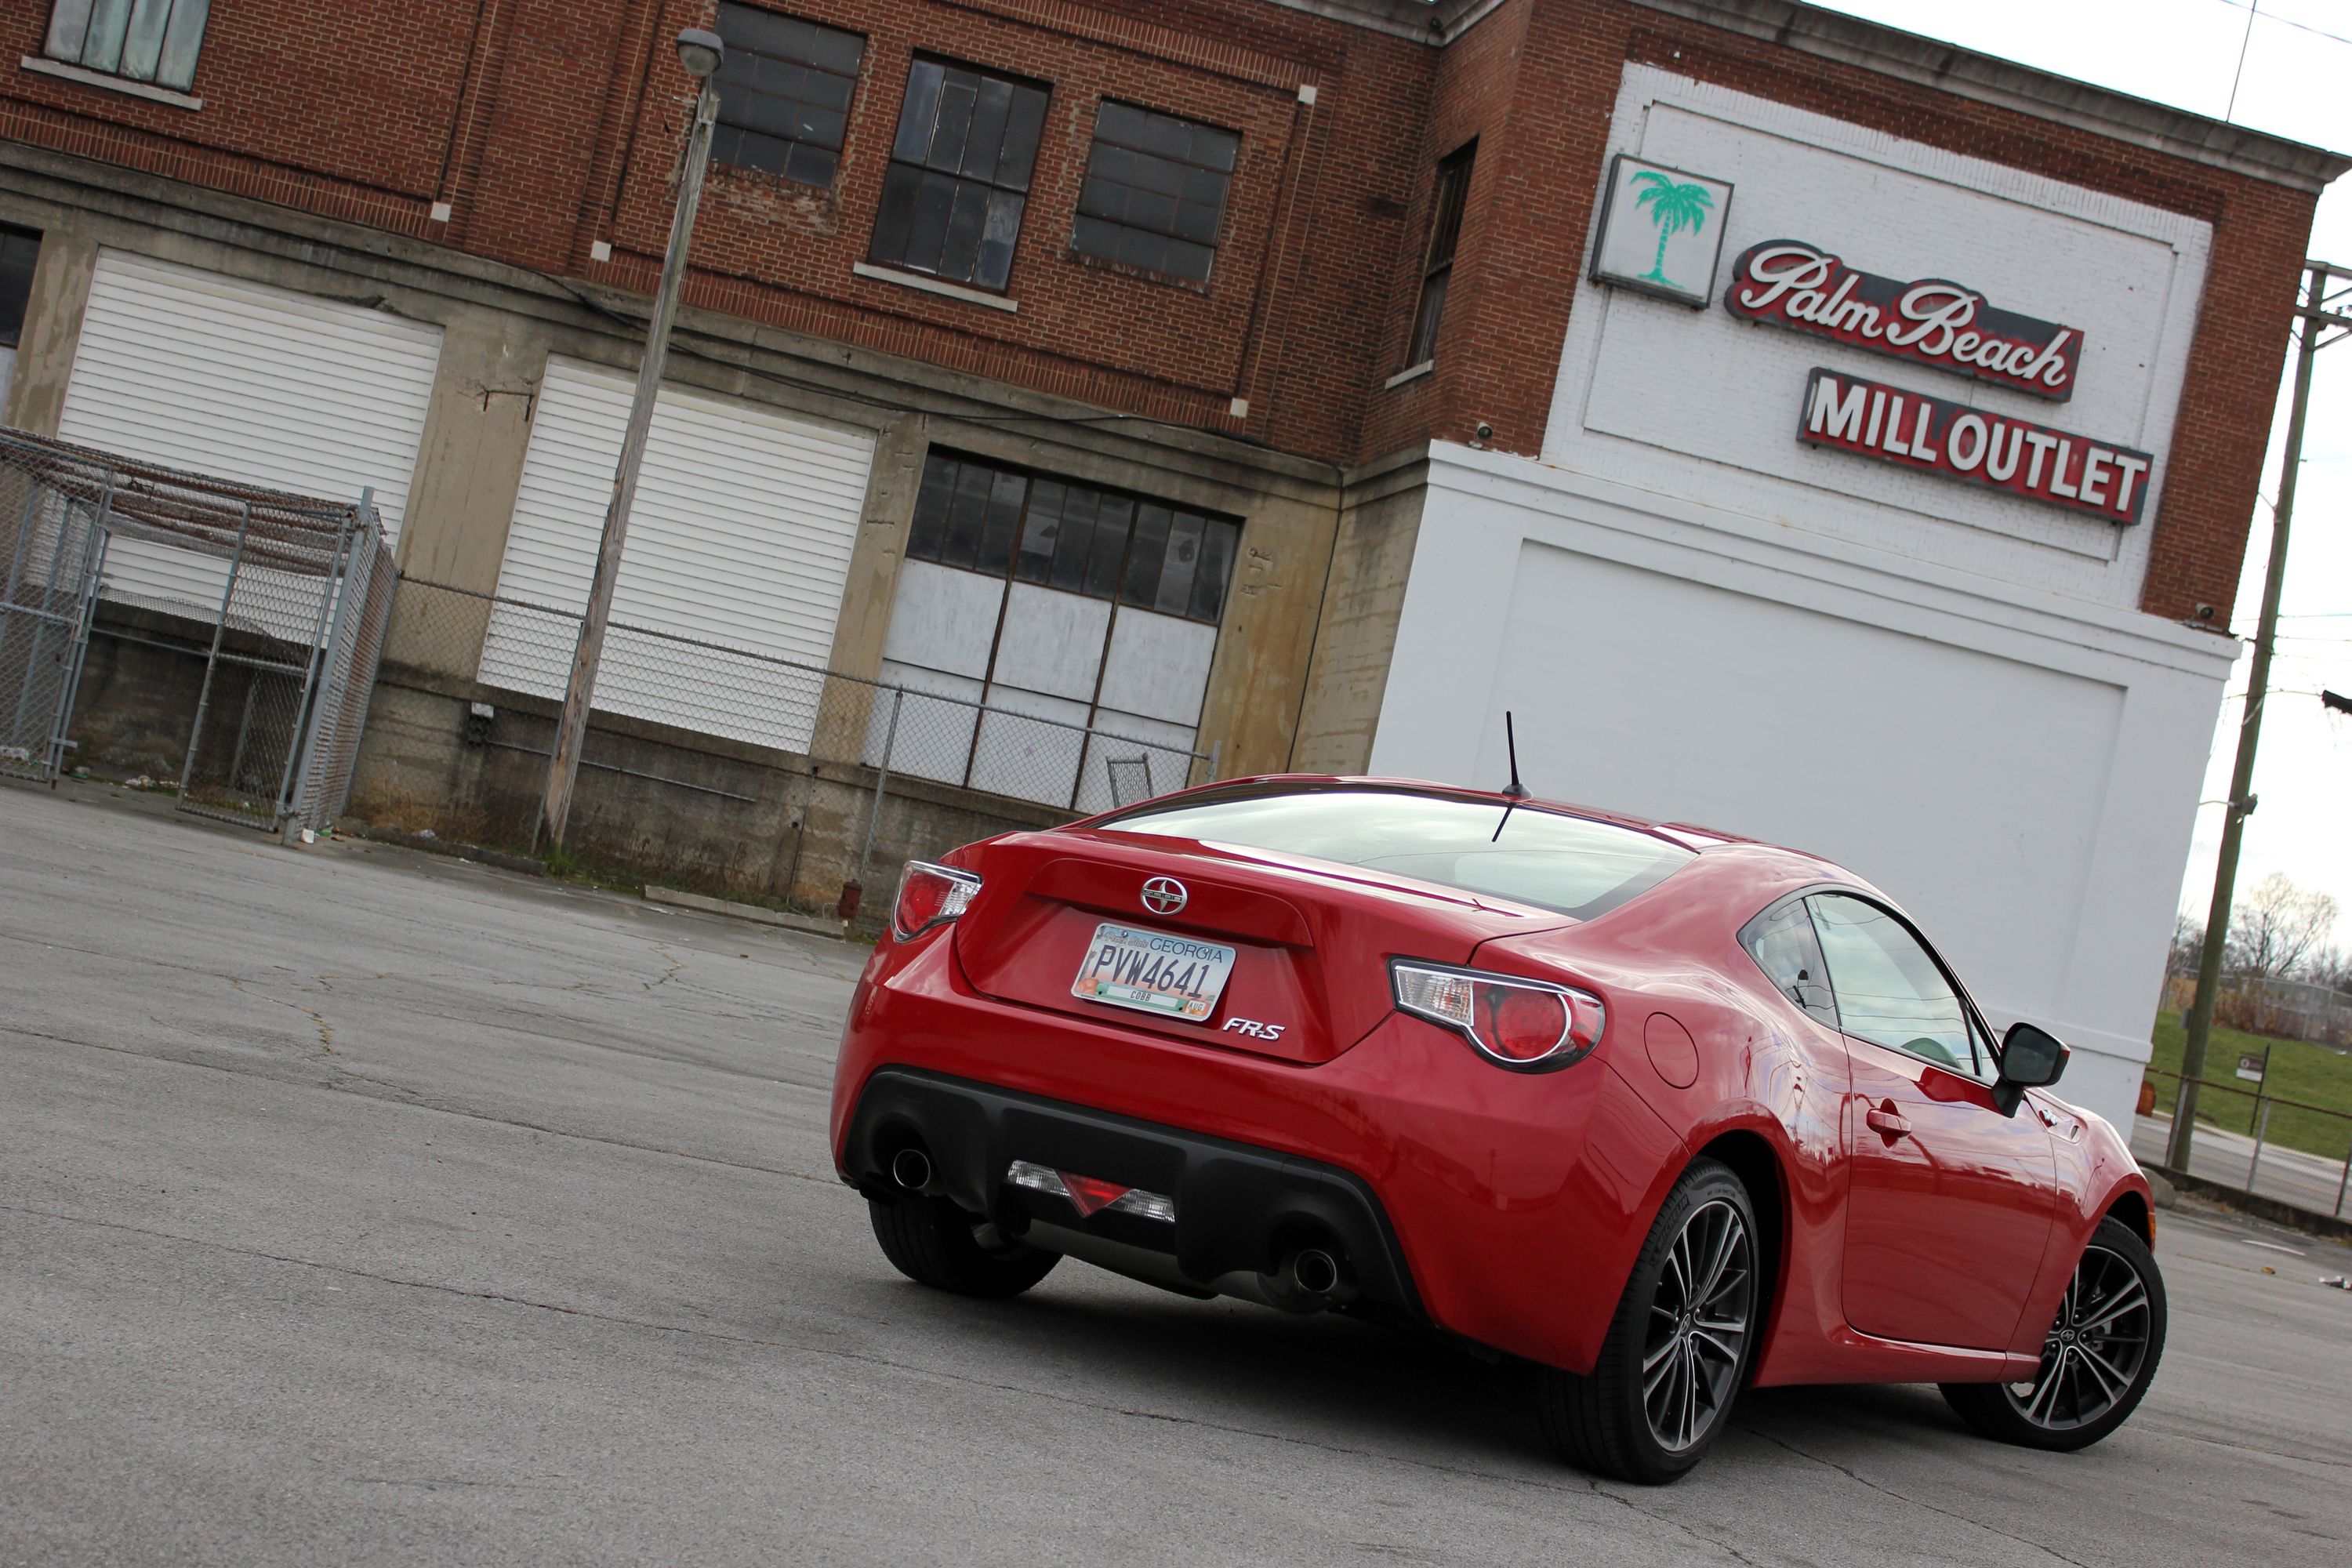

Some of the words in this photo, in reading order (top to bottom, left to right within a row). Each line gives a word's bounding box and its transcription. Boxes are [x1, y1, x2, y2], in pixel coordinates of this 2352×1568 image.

[1740, 246, 1882, 338] Palm
[1886, 285, 2071, 387] Beach
[1809, 376, 1937, 463] MILL
[1947, 414, 2147, 512] OUTLET
[1149, 938, 1223, 964] GEORGIA
[1091, 945, 1210, 999] PVW4641
[1130, 990, 1152, 1002] COBB
[1188, 1002, 1203, 1011] AUG
